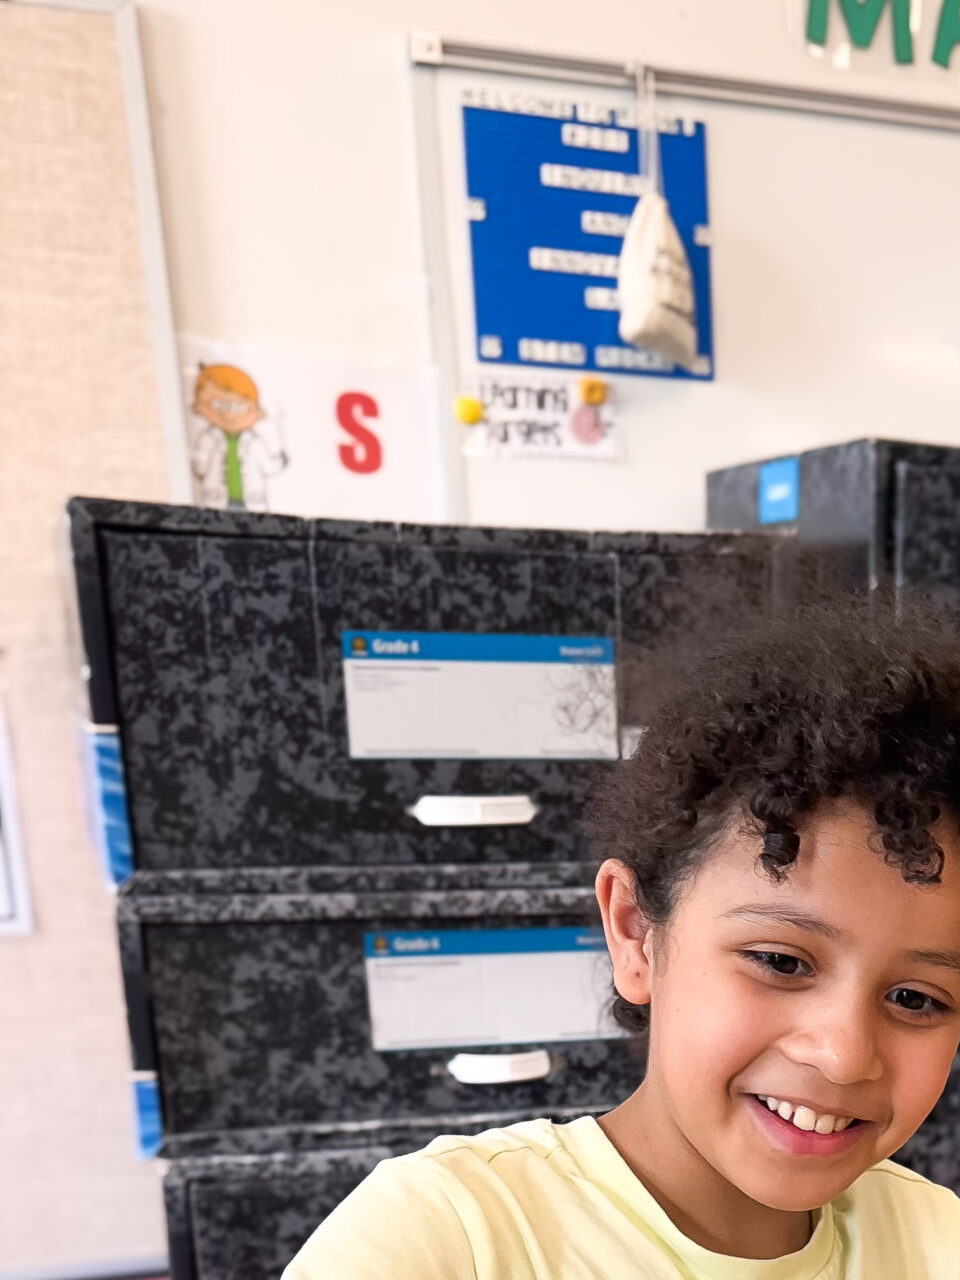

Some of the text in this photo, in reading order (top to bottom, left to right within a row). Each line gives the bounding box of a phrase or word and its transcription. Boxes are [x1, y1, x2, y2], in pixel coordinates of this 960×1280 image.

[462, 87, 569, 115] WELCOME
[335, 391, 382, 474] S
[371, 639, 410, 654] Grade
